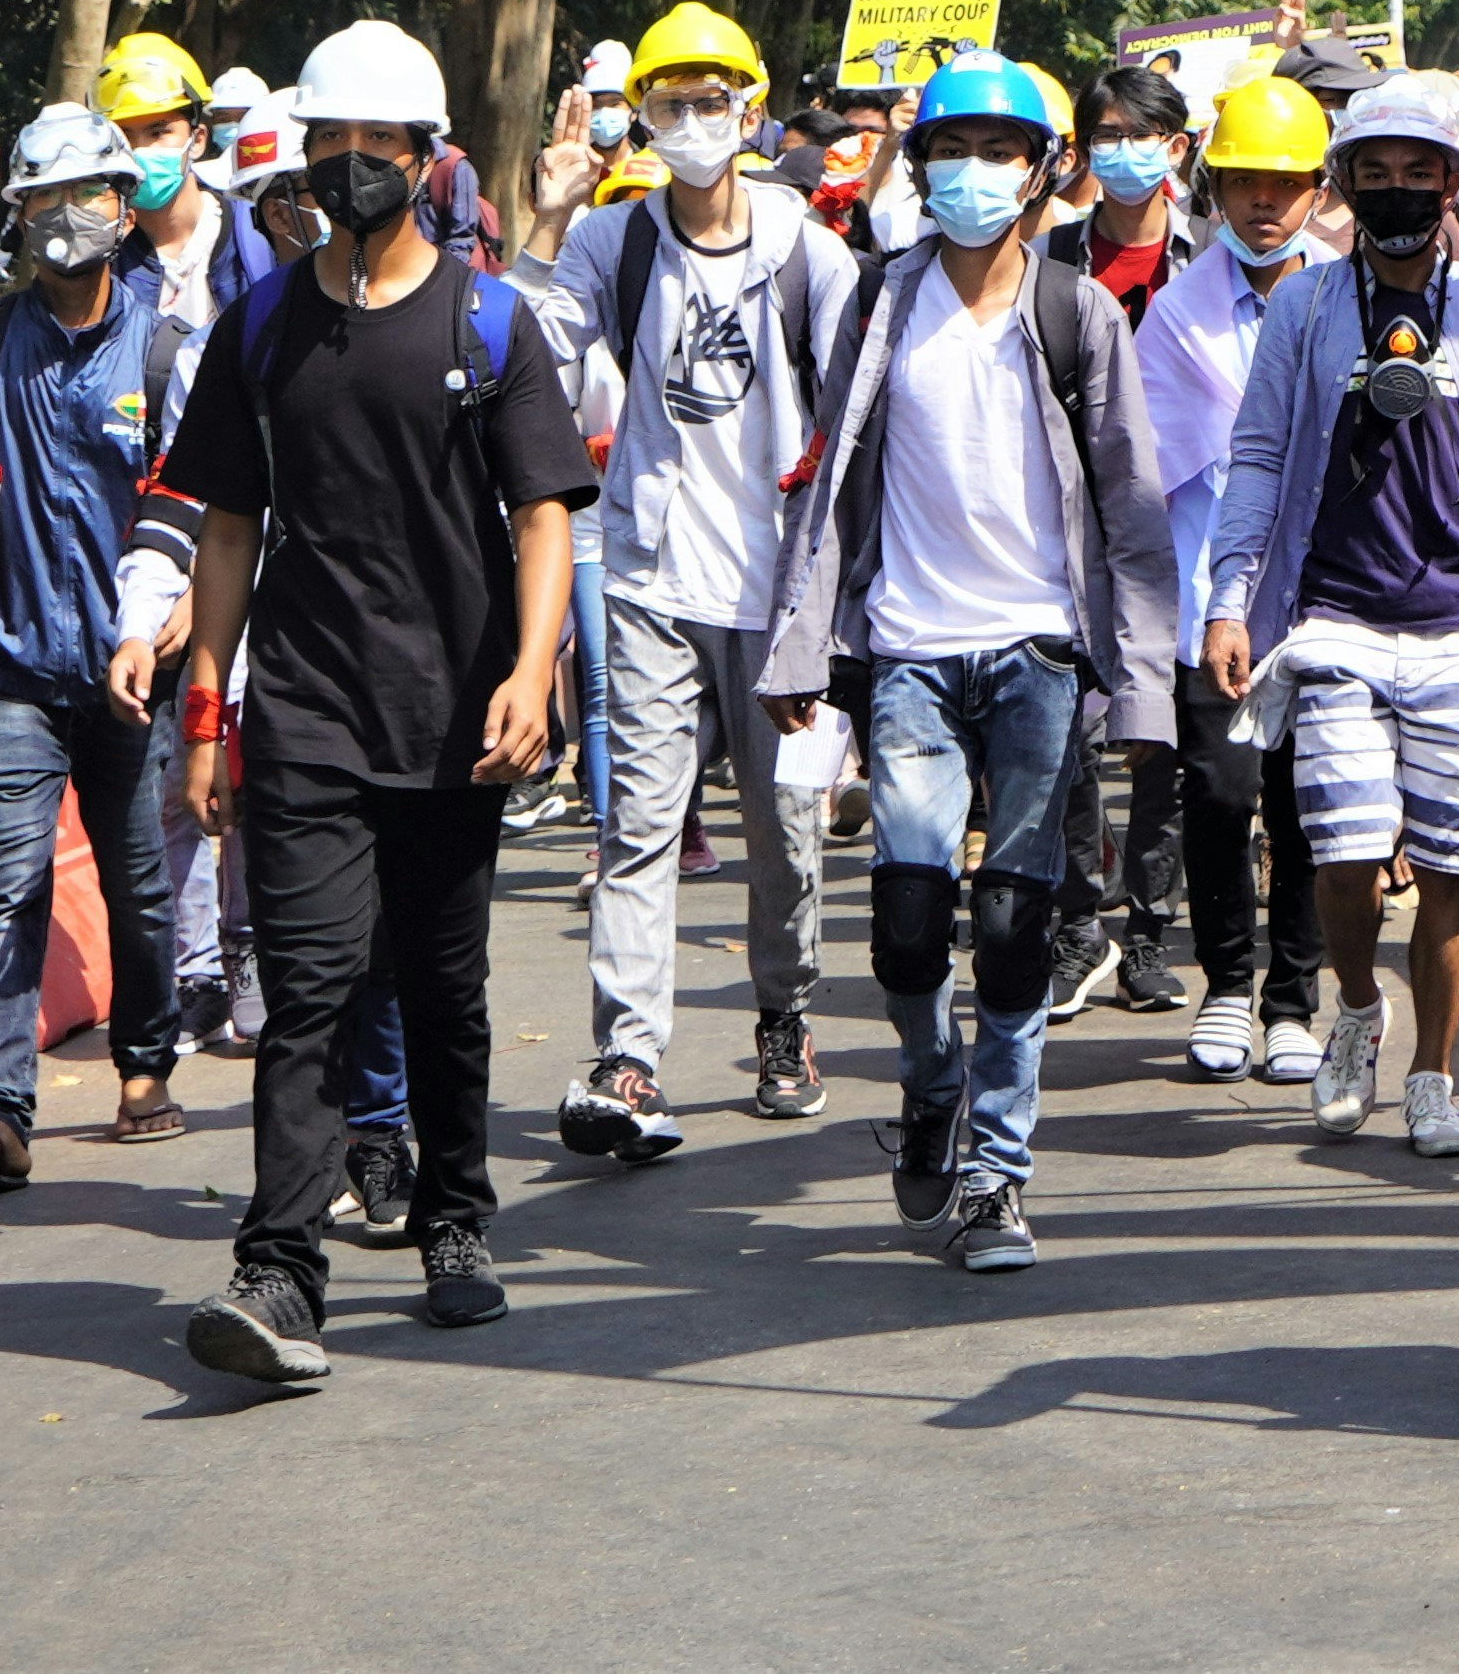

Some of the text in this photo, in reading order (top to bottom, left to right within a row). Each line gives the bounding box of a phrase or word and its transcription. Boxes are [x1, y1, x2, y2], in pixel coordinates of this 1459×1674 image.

[857, 3, 990, 25] MILITARY COUP
[1124, 20, 1274, 54] IGHT FOR DEMOCRACY
